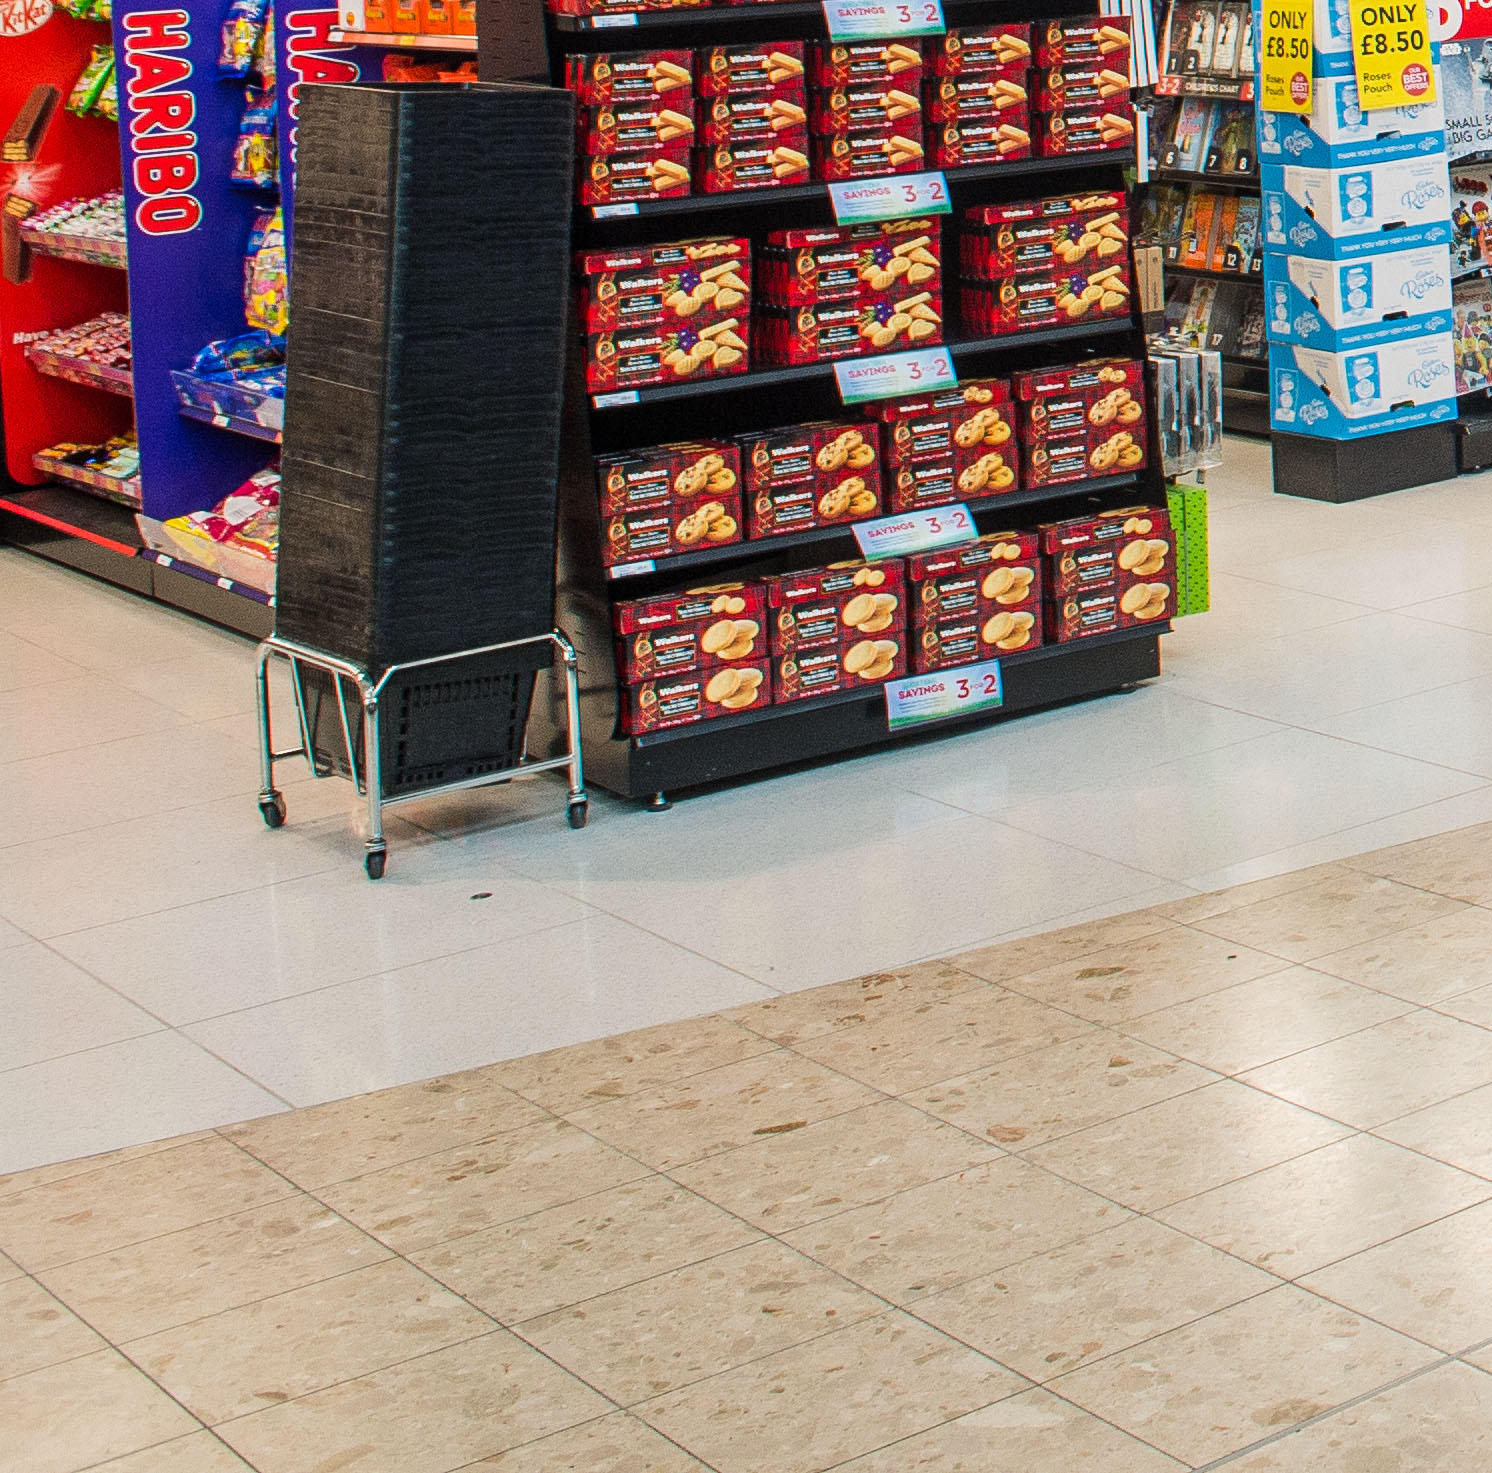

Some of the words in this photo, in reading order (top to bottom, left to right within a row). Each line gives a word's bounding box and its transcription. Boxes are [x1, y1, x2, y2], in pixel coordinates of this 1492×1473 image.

[1, 0, 46, 27] KitKat
[837, 8, 886, 18] SAVINGS
[897, 5, 911, 23] 3
[923, 4, 939, 22] 2
[1269, 10, 1307, 29] ONLY
[1361, 4, 1416, 27] ONLY
[1266, 39, 1309, 59] £8.50
[1360, 30, 1424, 56] £8.50
[612, 62, 654, 75] Walkers
[1363, 71, 1392, 82] Roses
[1266, 75, 1284, 85] Roses
[1291, 81, 1309, 91] BEST
[1403, 73, 1428, 84] BEST
[1265, 86, 1284, 97] Pouch
[1363, 83, 1393, 94] Pouch
[1404, 83, 1428, 91] OFFERS
[122, 8, 203, 236] HARIBO
[843, 188, 891, 200] SAVINGS
[901, 185, 916, 204] 3
[929, 183, 945, 202] 2
[1401, 184, 1444, 209] Roses
[619, 277, 664, 291] Walkers
[1400, 273, 1444, 300] Roses
[1407, 361, 1449, 388] Roses
[770, 444, 811, 457] Walkers
[658, 682, 700, 695] Walkers
